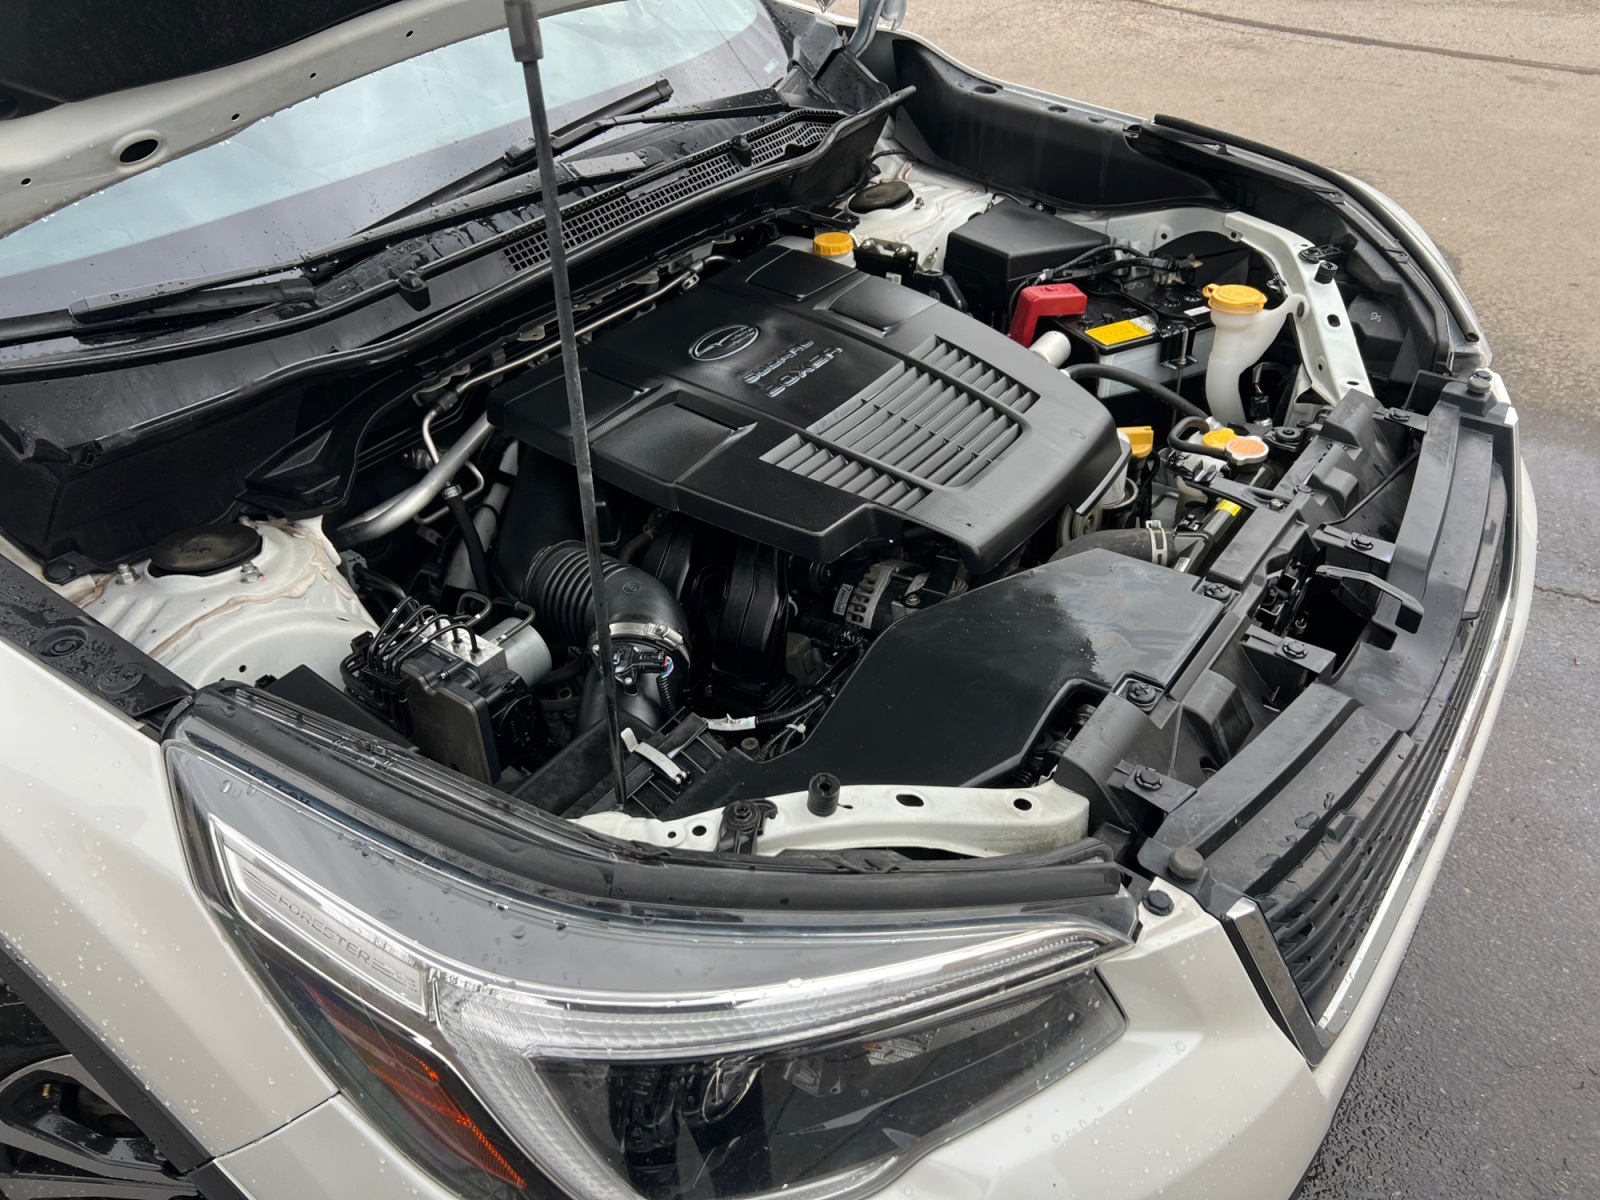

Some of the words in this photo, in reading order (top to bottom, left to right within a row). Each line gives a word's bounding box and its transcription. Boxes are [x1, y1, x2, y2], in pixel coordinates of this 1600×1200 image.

[742, 339, 814, 384] SUBARU
[759, 347, 844, 398] BOXER
[277, 896, 371, 964] FORESTER
